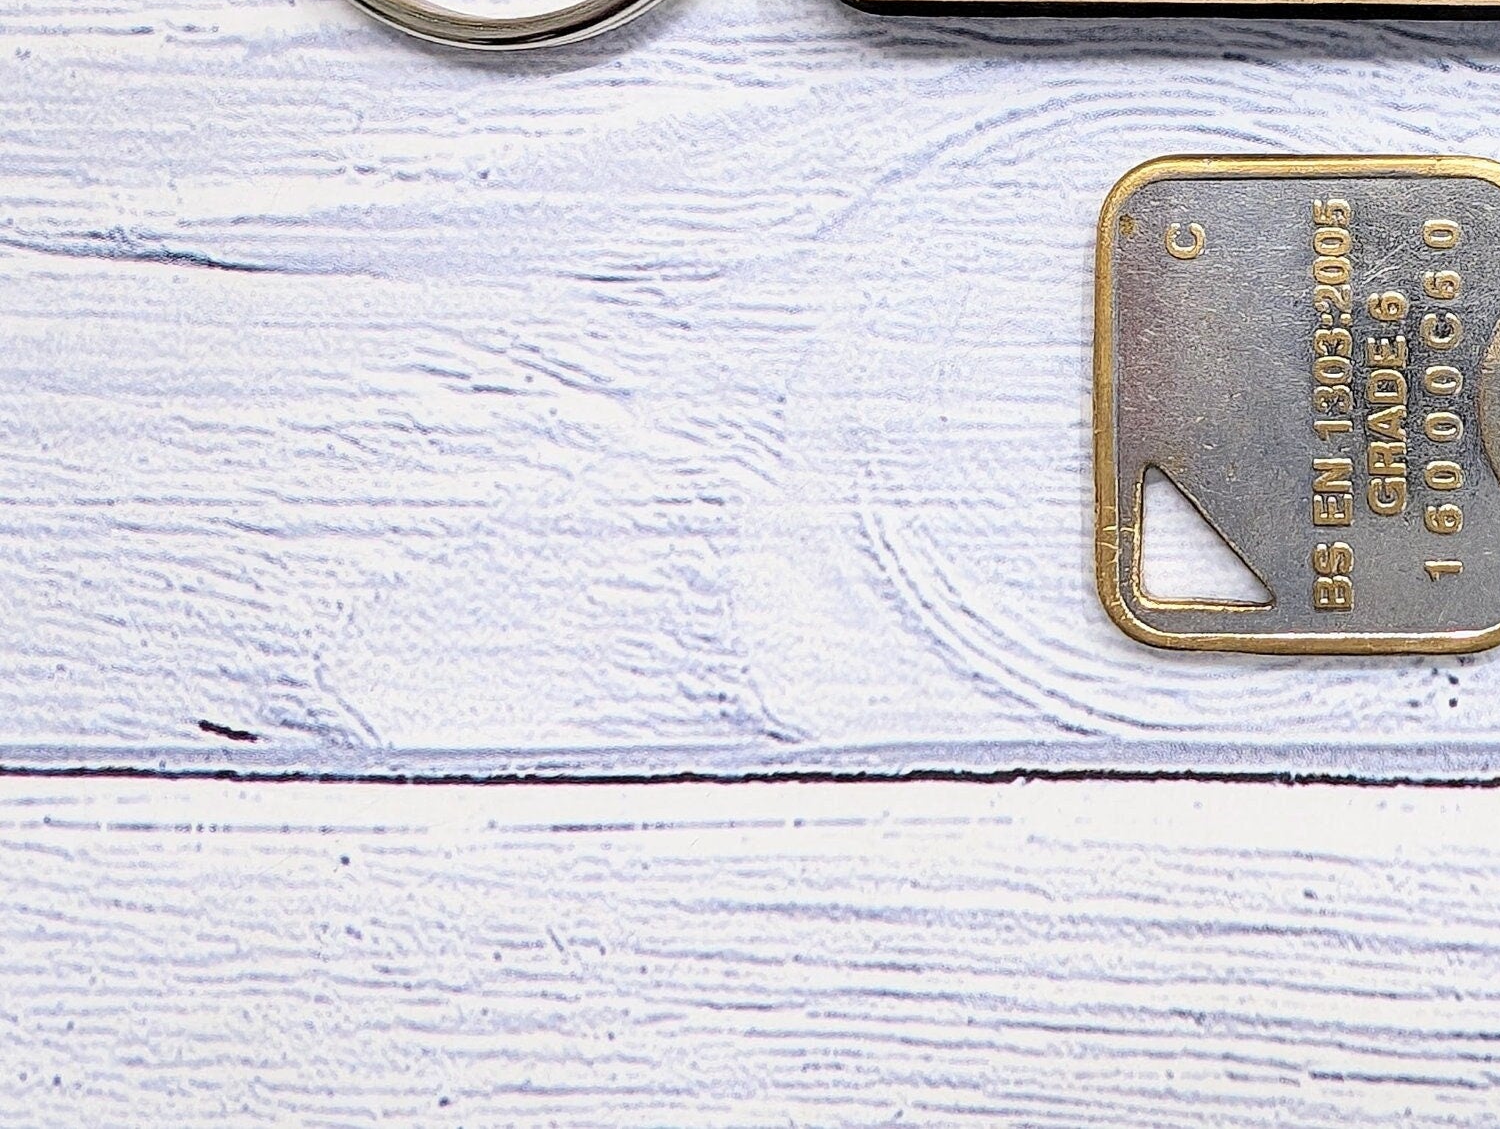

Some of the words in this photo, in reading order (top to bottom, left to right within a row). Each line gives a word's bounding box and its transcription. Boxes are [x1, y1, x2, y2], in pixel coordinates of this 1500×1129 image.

[1165, 221, 1205, 260] C
[1313, 198, 1354, 442] 1303:2005
[1368, 290, 1410, 323] 6
[1367, 335, 1408, 516] GRADE
[1313, 458, 1354, 527] EN
[1313, 541, 1354, 611] BS
